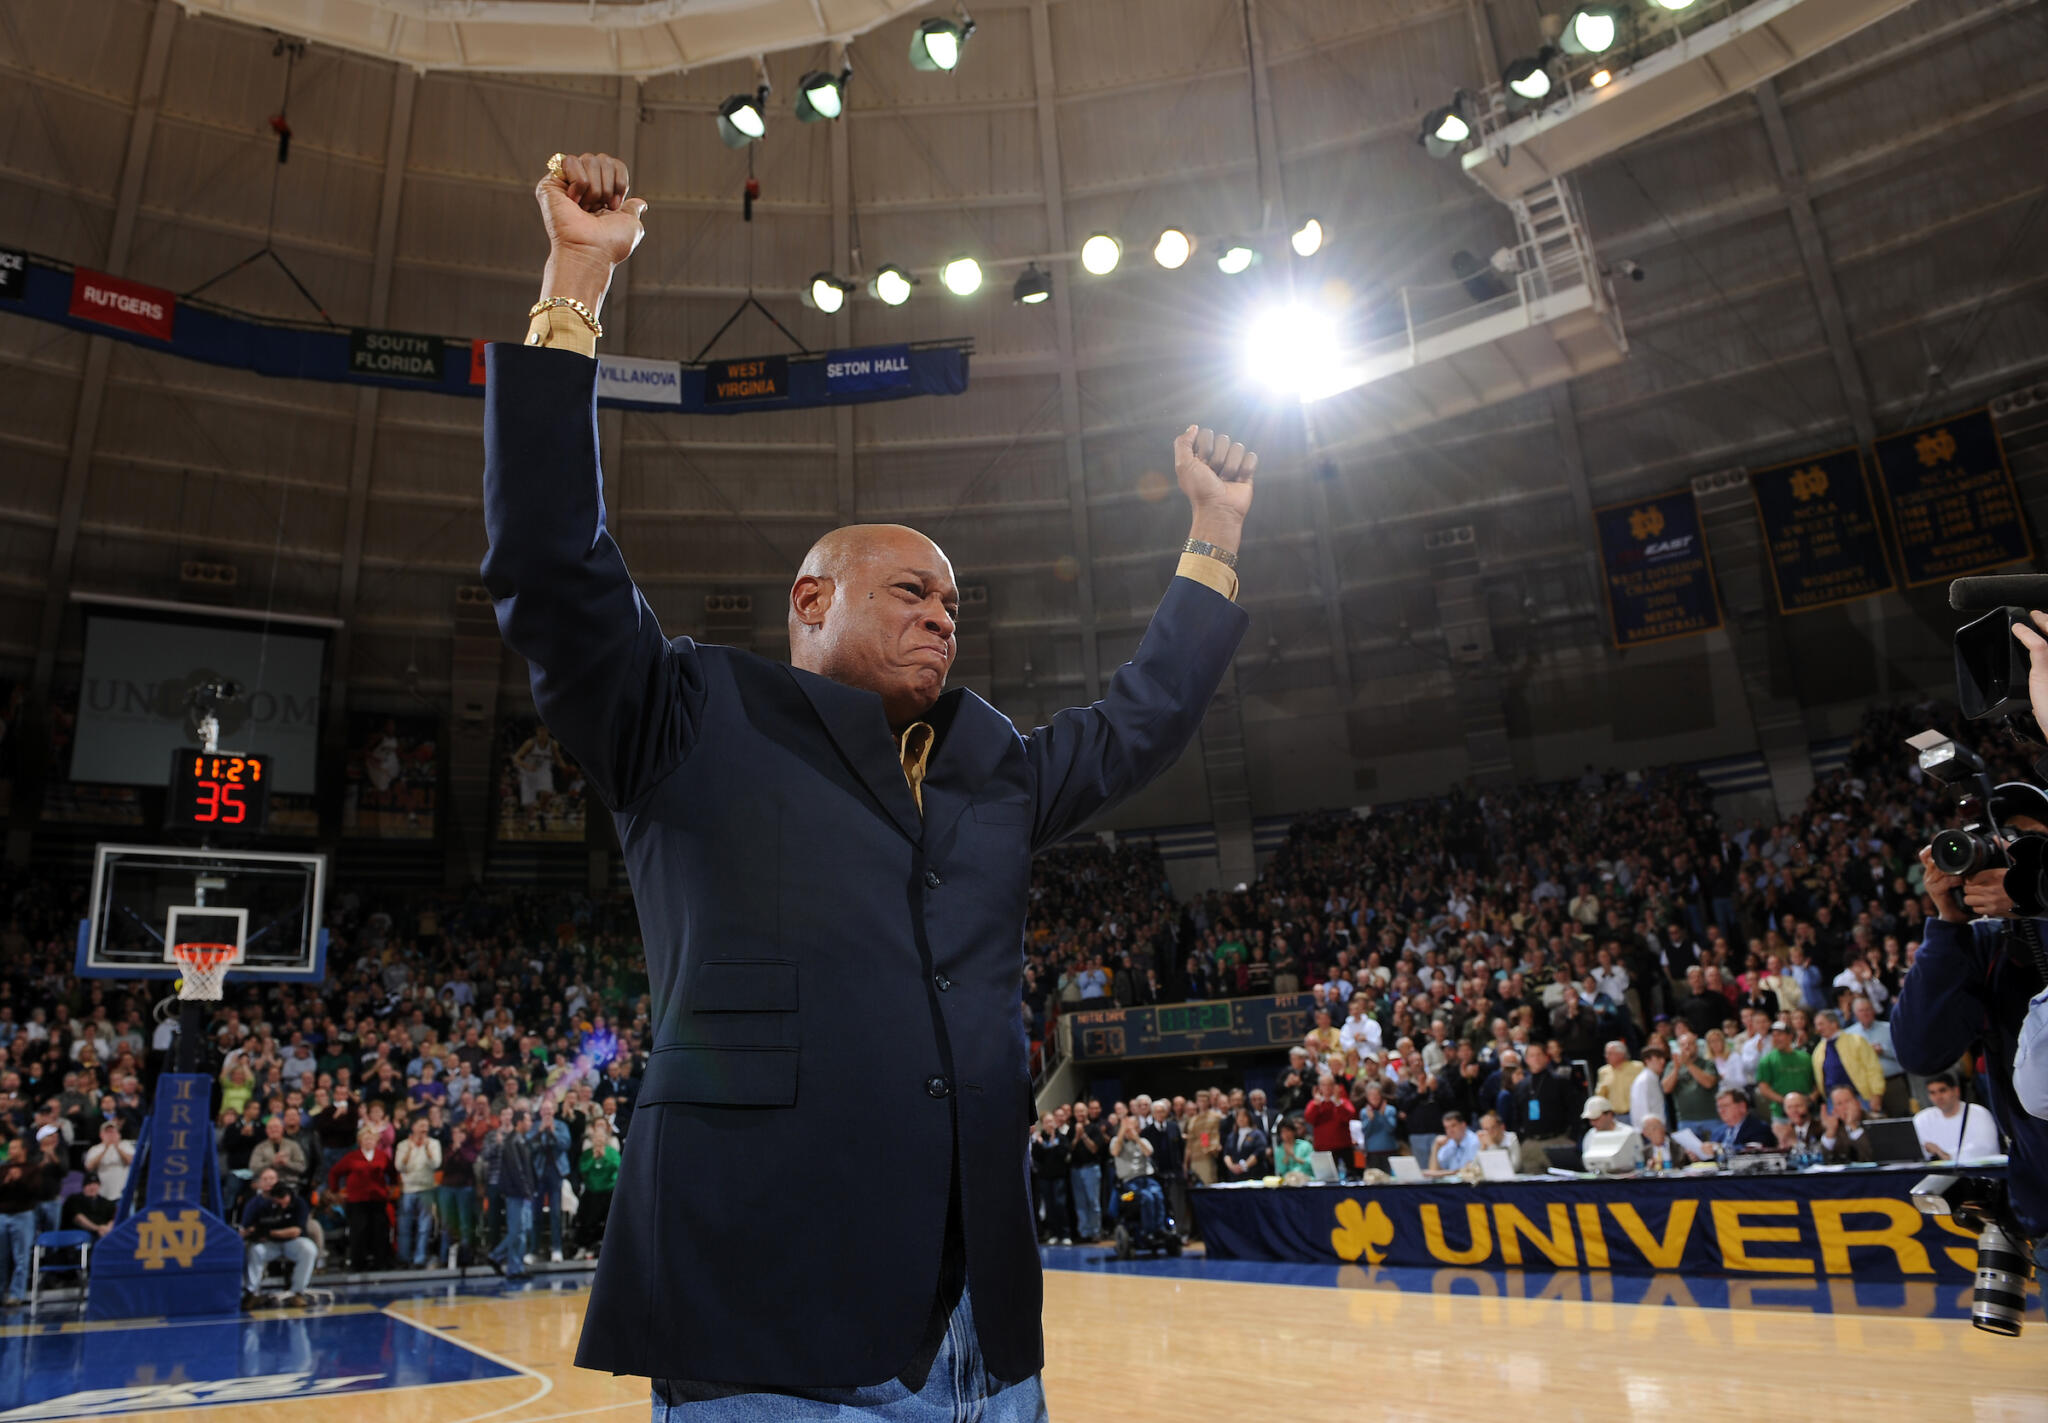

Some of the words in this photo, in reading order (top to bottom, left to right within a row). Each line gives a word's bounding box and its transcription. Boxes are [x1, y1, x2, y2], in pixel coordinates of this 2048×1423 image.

[83, 285, 164, 321] RUTGERS
[366, 333, 429, 354] SOUTH
[354, 351, 436, 374] FLORIDA
[727, 360, 767, 377] WEST
[826, 359, 873, 378] SETON
[874, 356, 909, 373] HALL
[600, 366, 677, 386] VILLANOVA
[716, 379, 776, 398] VIRGINIA
[1644, 535, 1693, 555] EAST
[194, 757, 261, 783] 11:27
[194, 780, 247, 824] 35
[163, 1080, 195, 1201] IRISH
[134, 1209, 207, 1270] ND
